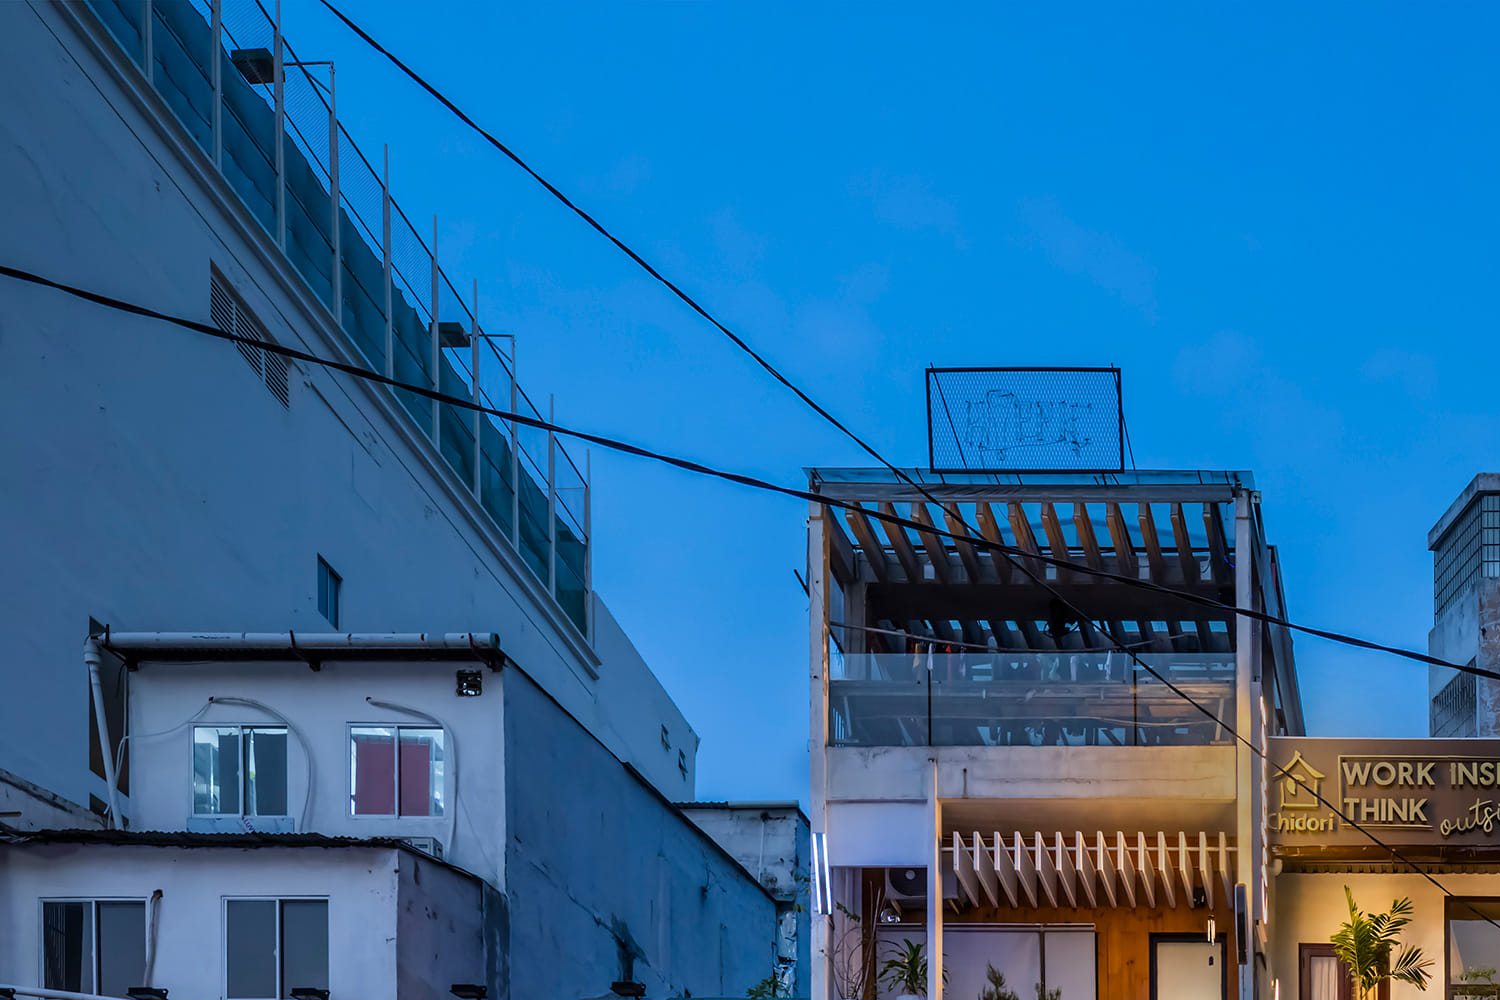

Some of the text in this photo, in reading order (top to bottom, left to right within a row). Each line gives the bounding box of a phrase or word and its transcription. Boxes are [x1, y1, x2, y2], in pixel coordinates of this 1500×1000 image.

[1342, 761, 1435, 786] WORK
[1268, 810, 1334, 833] Chidori
[1343, 797, 1428, 822] THINK
